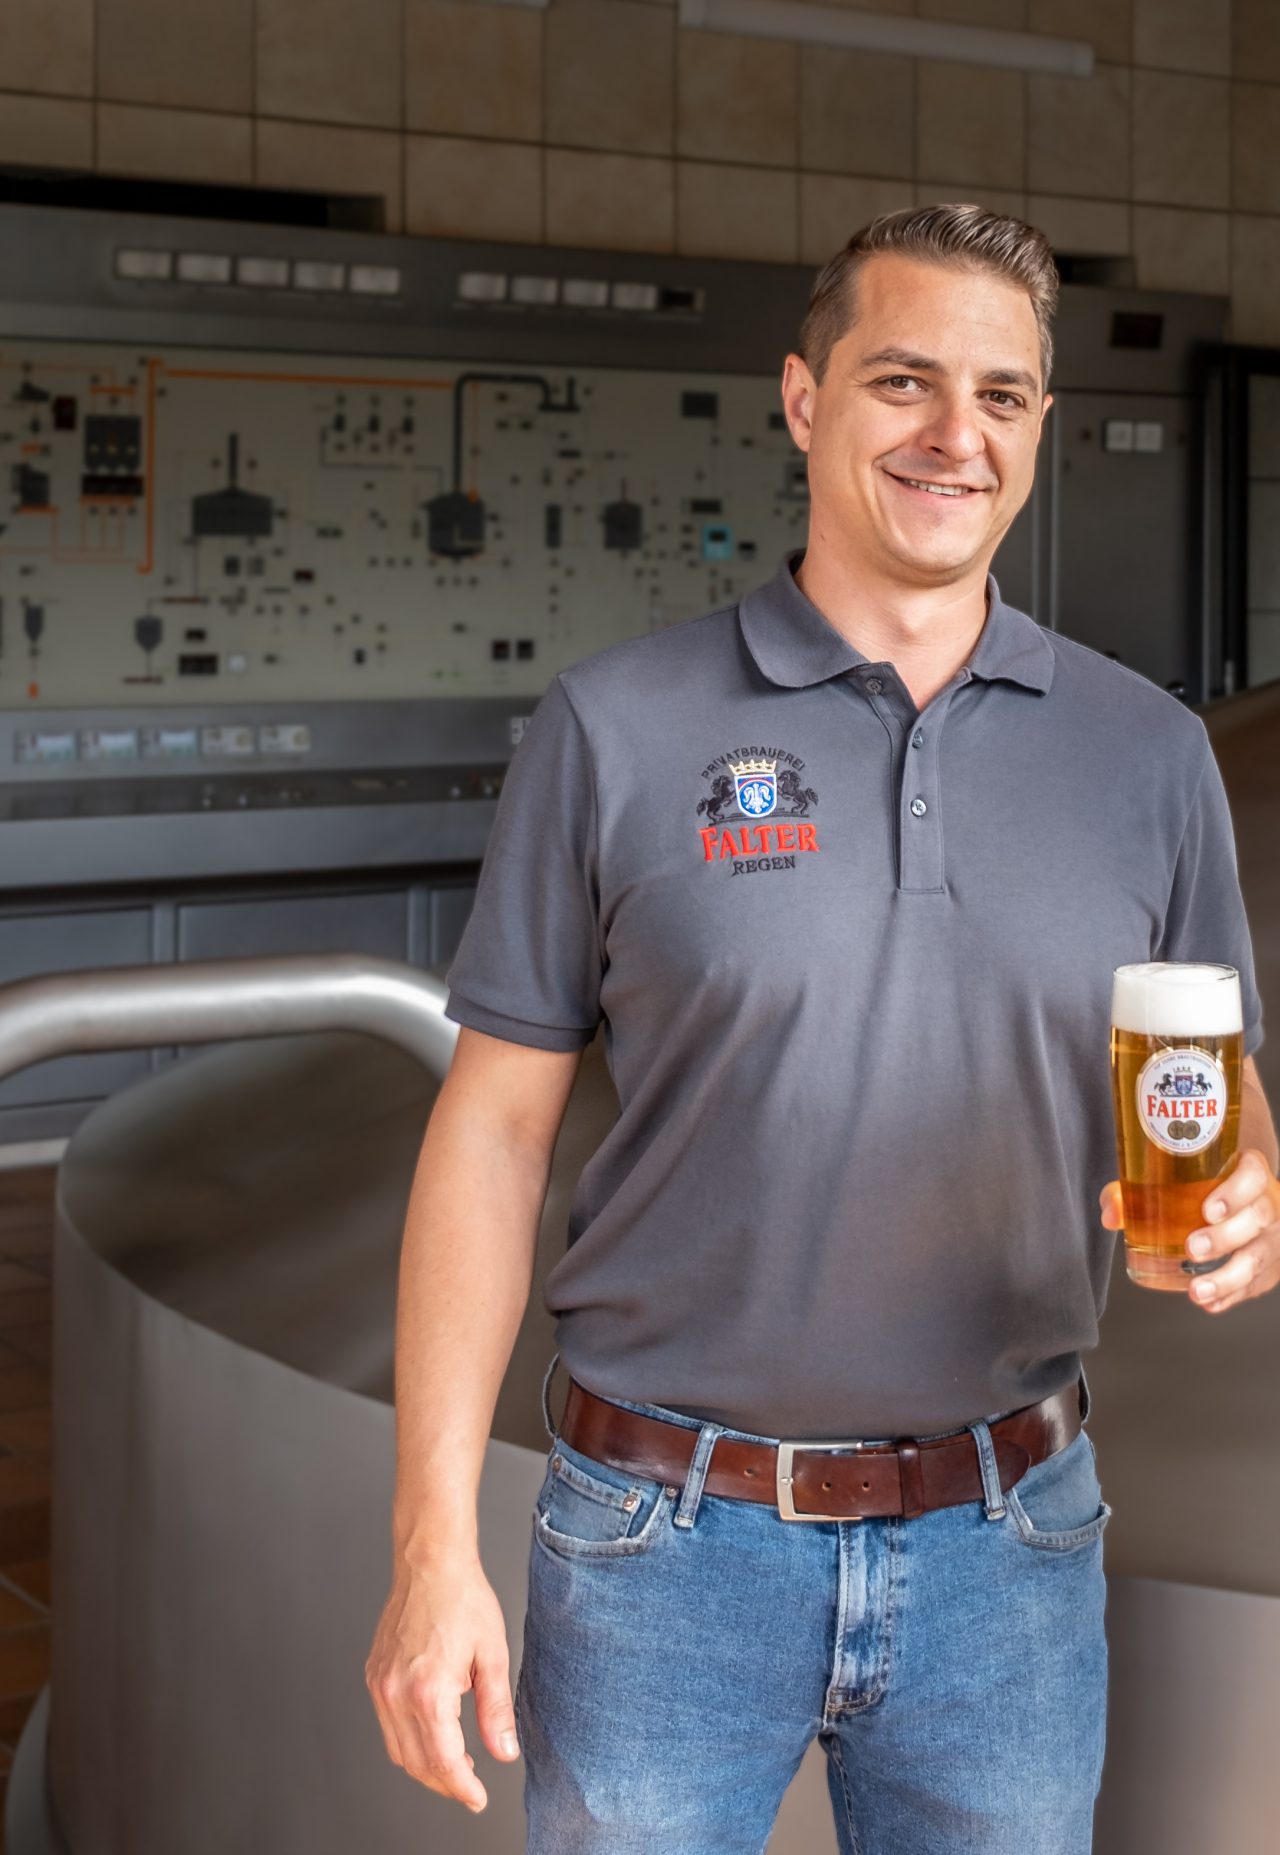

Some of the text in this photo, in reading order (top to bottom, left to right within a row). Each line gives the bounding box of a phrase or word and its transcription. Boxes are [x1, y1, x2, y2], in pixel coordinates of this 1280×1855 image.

[701, 746, 806, 780] PRIVATBRAUEREI
[699, 823, 819, 862] FALTER
[732, 855, 796, 877] REGEN
[1146, 1095, 1217, 1118] FALTER
